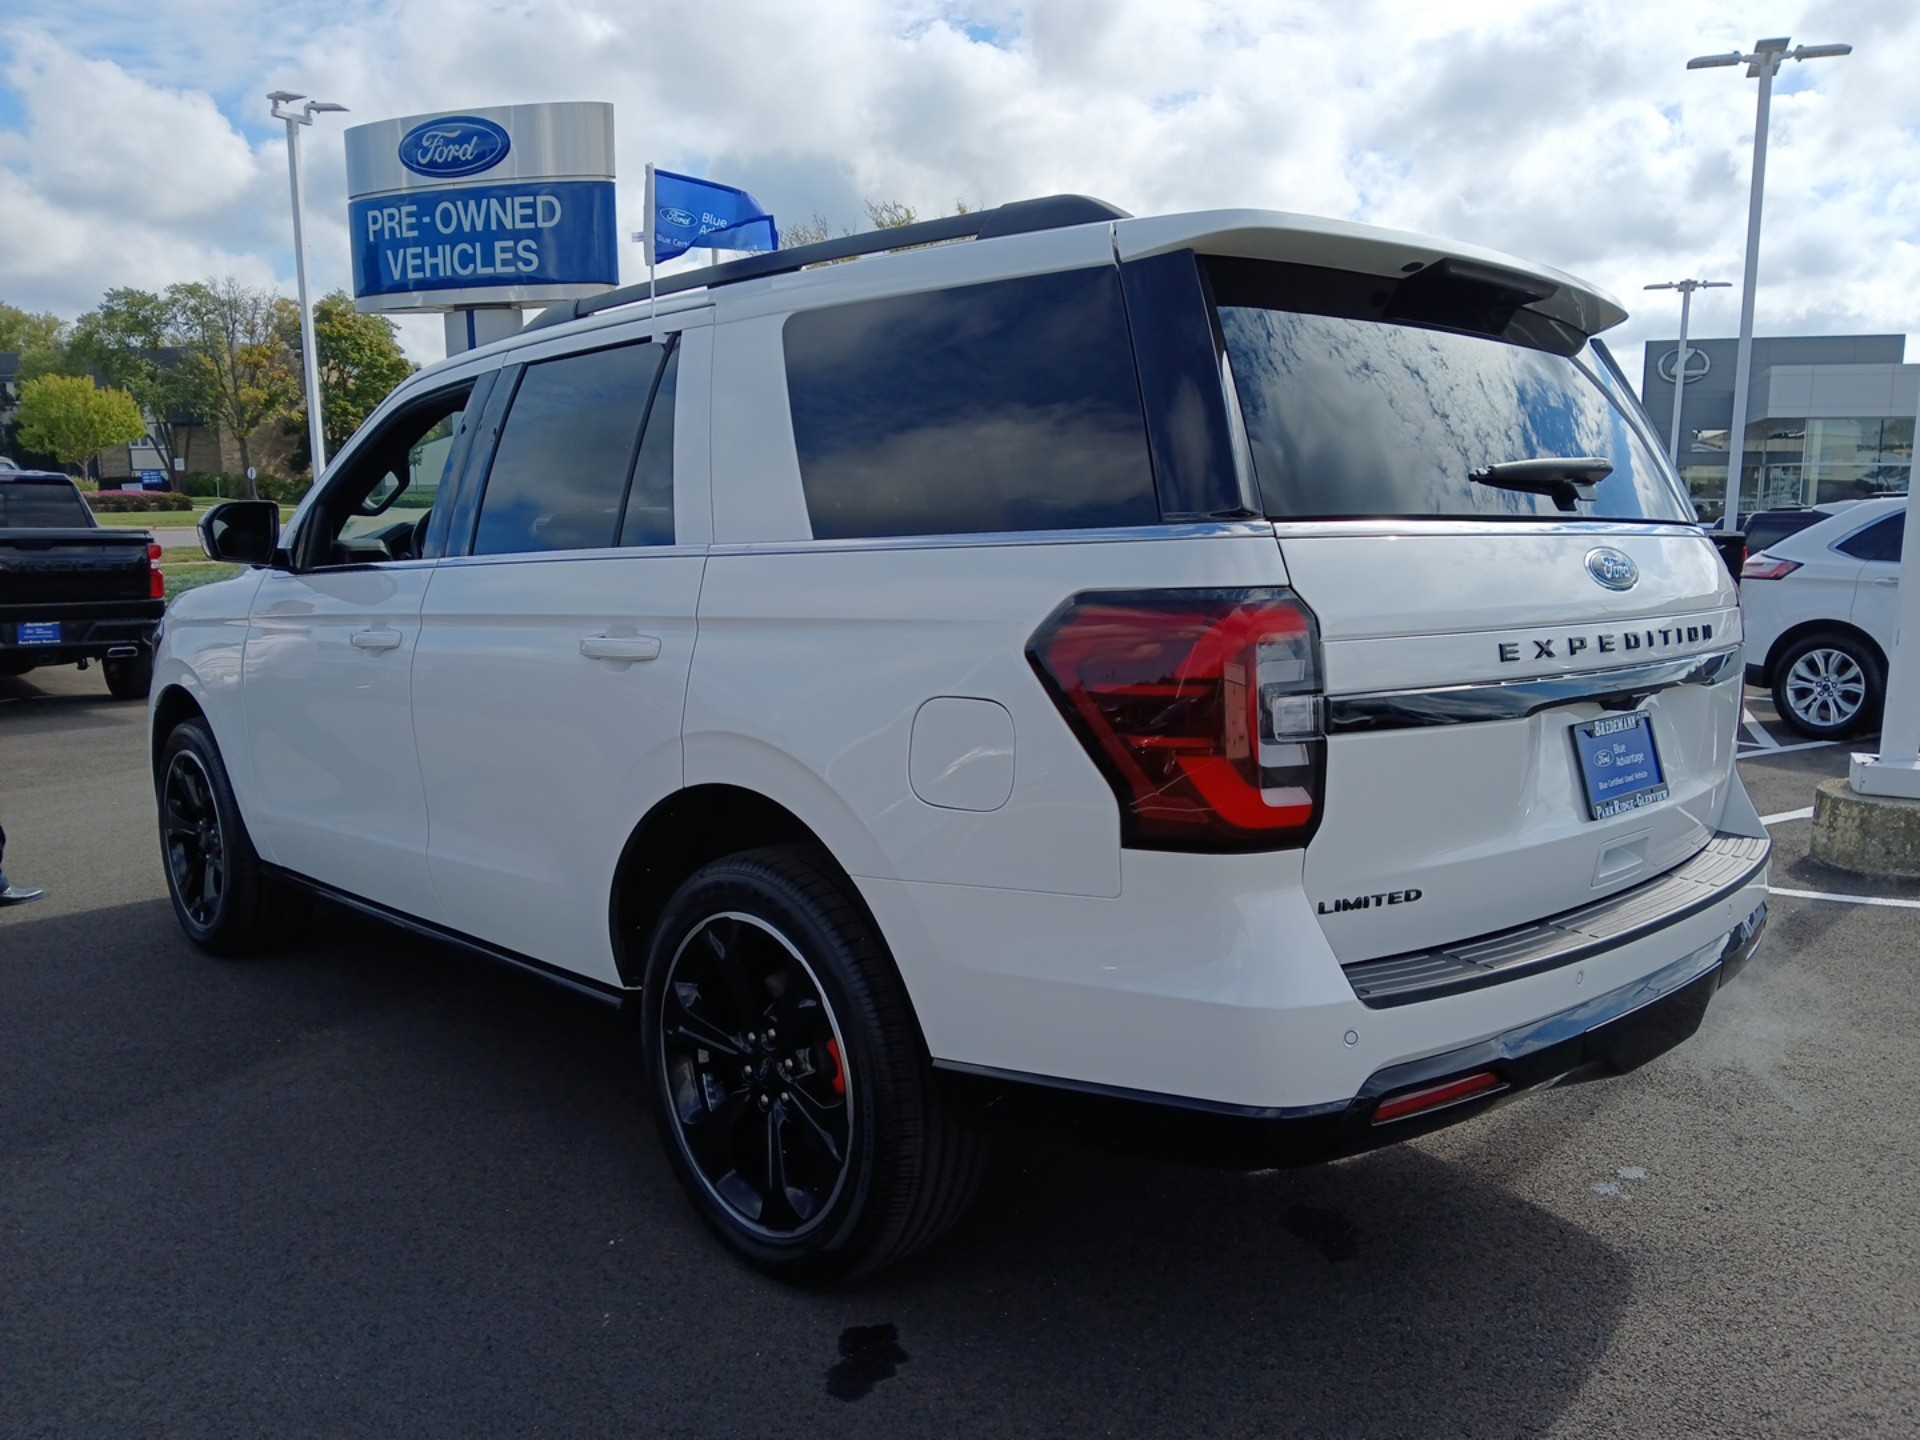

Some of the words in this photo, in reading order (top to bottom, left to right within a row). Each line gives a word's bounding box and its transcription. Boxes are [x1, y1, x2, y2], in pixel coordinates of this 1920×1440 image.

[417, 129, 478, 165] Ford
[367, 194, 562, 242] PRE-OWNED
[666, 208, 692, 225] Ford
[702, 212, 728, 228] Blue
[386, 239, 540, 281] VEHICLES
[1601, 555, 1631, 579] Ford
[1498, 623, 1713, 663] EXPEDITION
[1317, 888, 1422, 915] LIMITED
